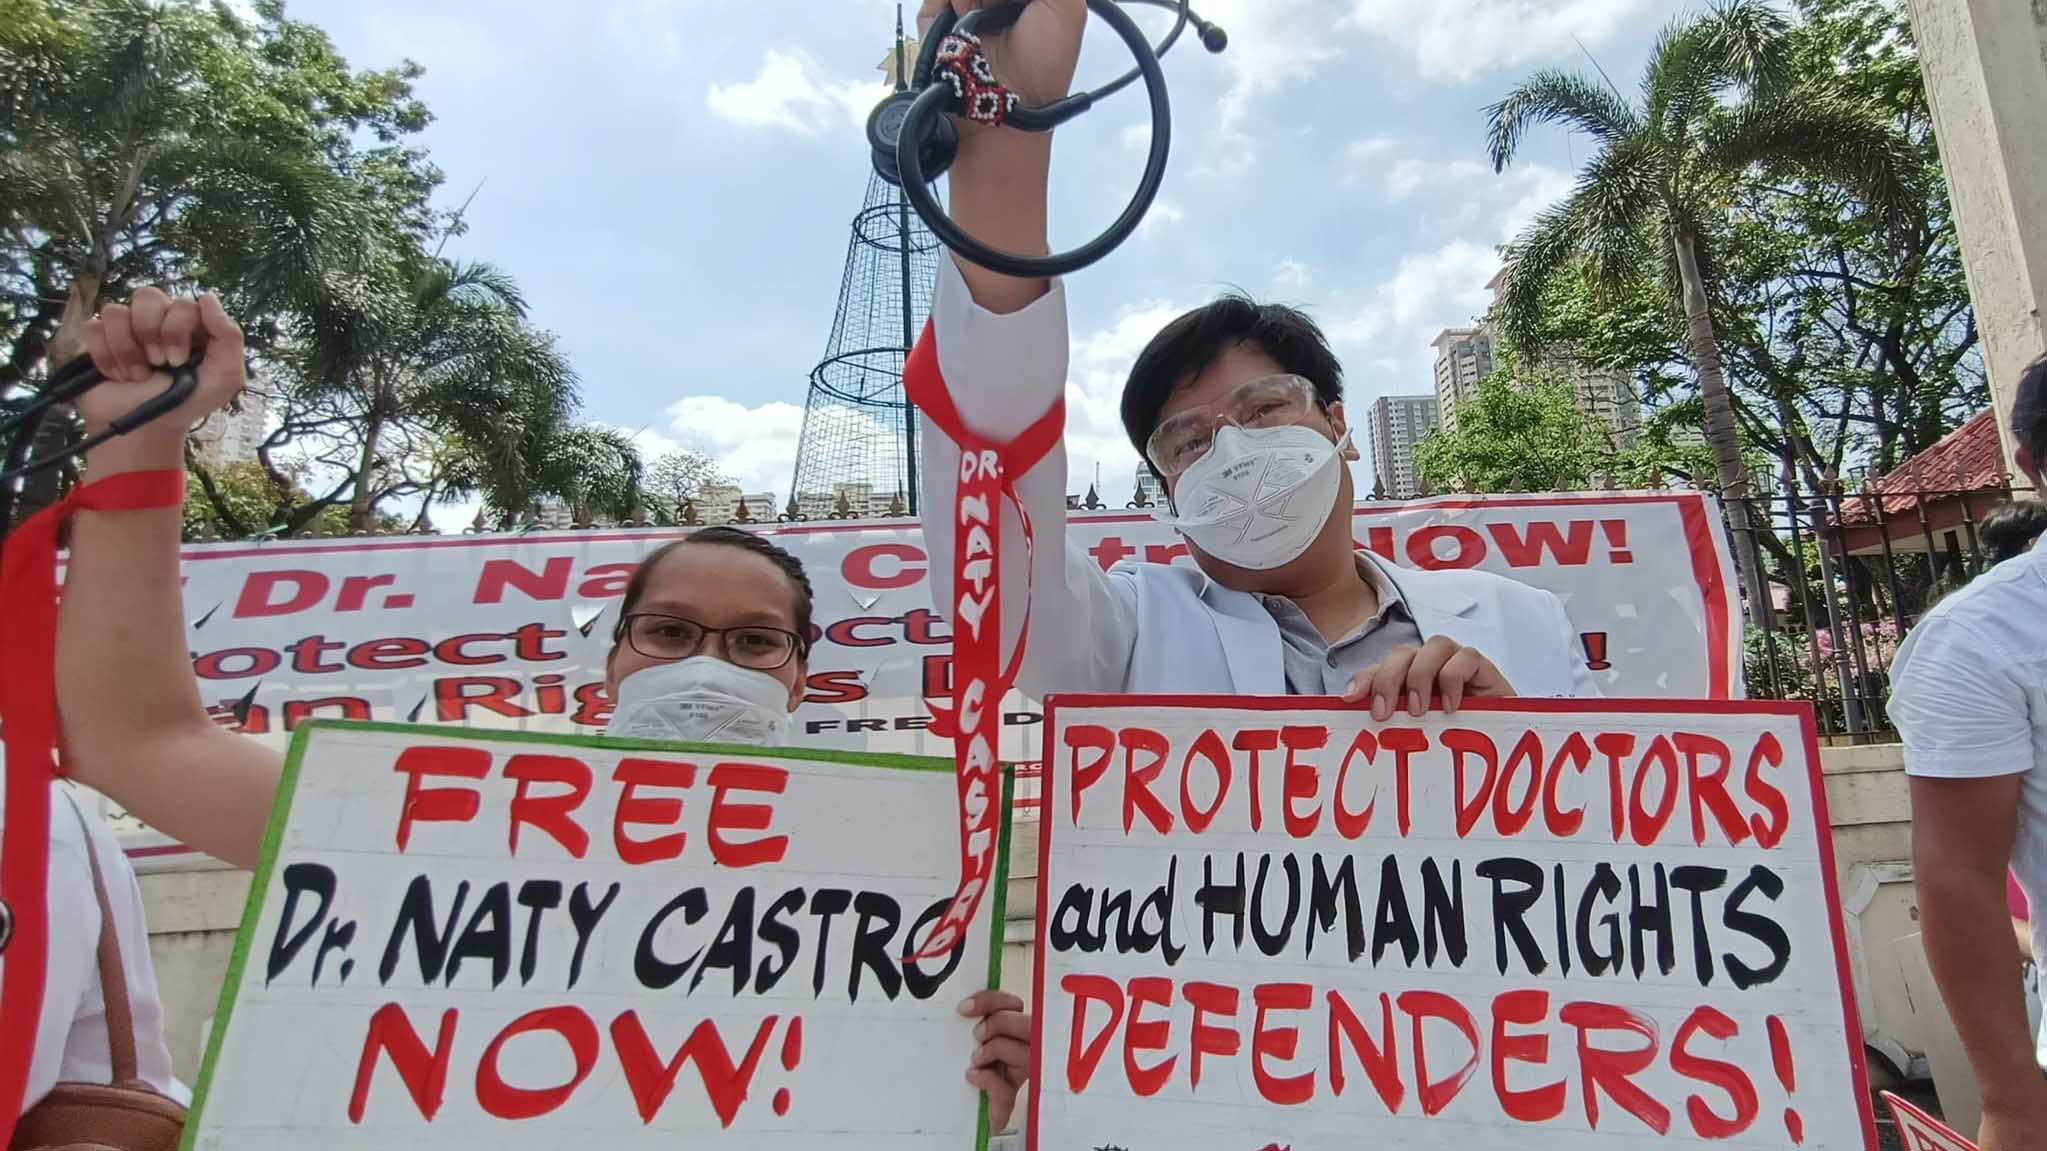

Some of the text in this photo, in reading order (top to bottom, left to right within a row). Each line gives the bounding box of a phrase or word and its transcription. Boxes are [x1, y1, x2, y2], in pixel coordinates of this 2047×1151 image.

[960, 450, 1005, 484] DR.
[232, 569, 416, 619] Dr.
[472, 555, 642, 605] Na
[957, 492, 997, 643] NATY
[193, 621, 567, 679] otect
[805, 715, 933, 735] FRE
[1063, 724, 1791, 851] PROTECT DOCTORS
[394, 746, 790, 869] FREE
[265, 862, 967, 1005] Dr. NATY CASTRO
[1049, 851, 1792, 991] and HUMAN RIGHTS
[347, 1002, 803, 1129] NOW!
[1060, 974, 1804, 1145] DEFENDERS!
